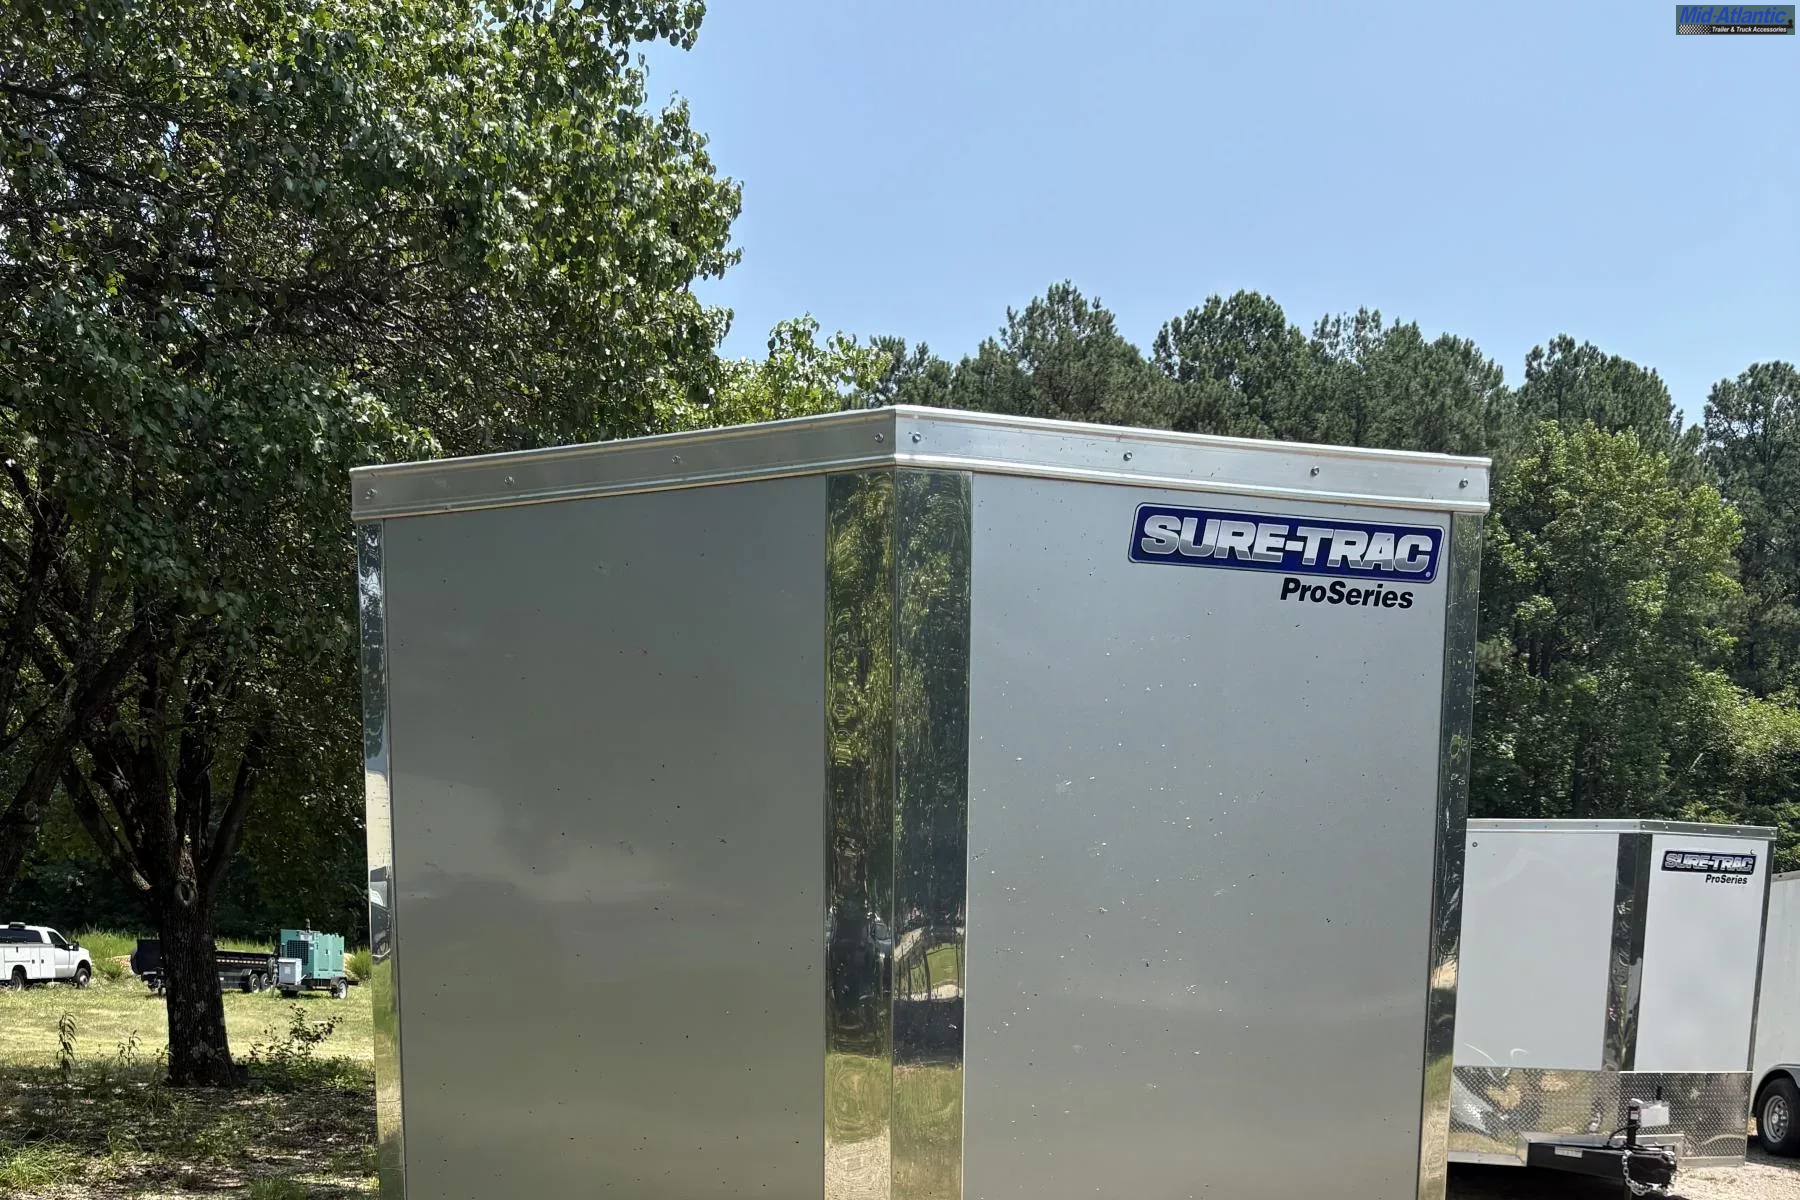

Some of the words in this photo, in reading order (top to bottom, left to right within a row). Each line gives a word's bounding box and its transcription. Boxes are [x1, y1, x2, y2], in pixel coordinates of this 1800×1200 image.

[1141, 514, 1433, 572] SURE-TRAC
[1280, 577, 1414, 609] ProSeries
[1664, 853, 1754, 872] SURE-TRAC
[1705, 874, 1748, 884] ProSeries
